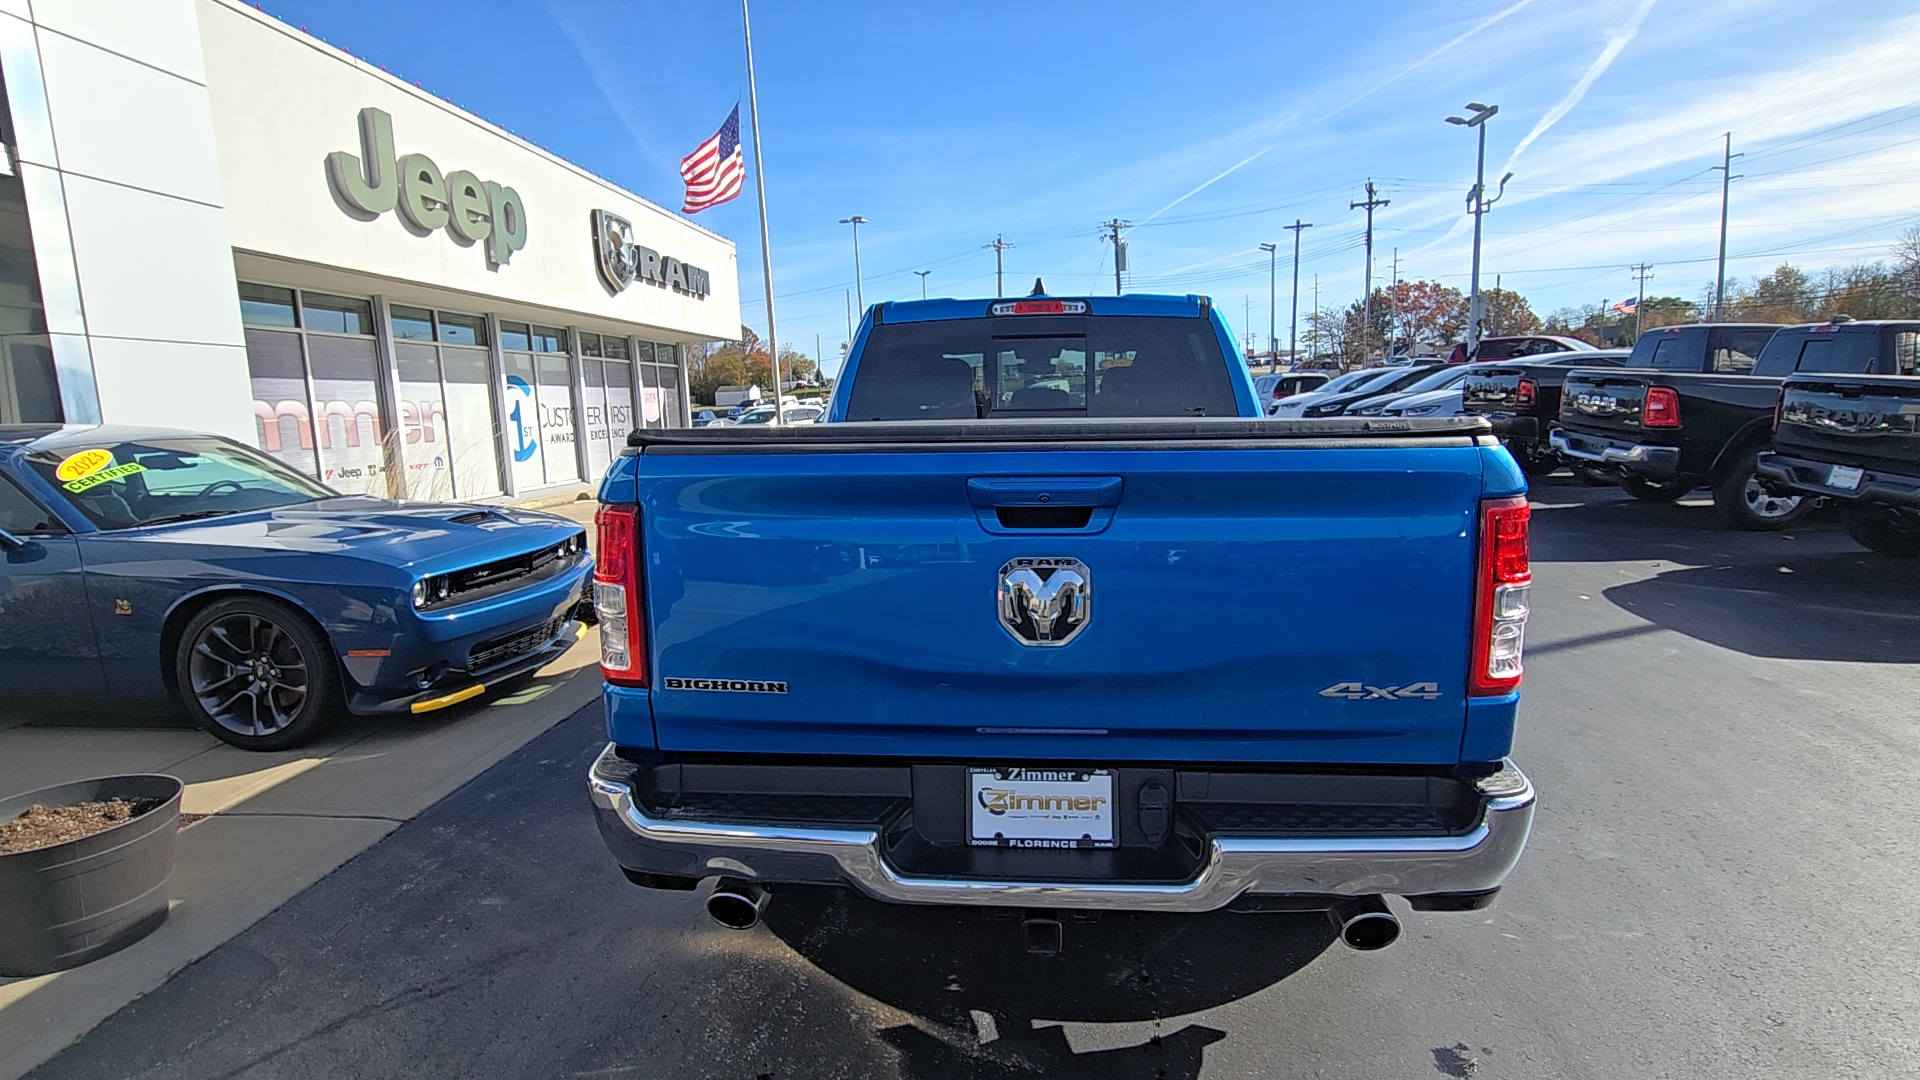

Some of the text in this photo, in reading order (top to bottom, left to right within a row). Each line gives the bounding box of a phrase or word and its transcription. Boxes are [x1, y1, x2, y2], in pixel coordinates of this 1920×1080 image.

[324, 107, 527, 272] Jeep
[634, 245, 711, 300] RAM
[1577, 395, 1617, 407] RAM
[1810, 407, 1883, 426] RAM
[551, 432, 576, 445] AWARD
[66, 452, 105, 476] 2023
[338, 467, 362, 479] Jeep
[68, 464, 140, 491] CERTIFIED
[664, 677, 788, 694] BIGHORN
[1318, 682, 1443, 700] 4x4
[1008, 767, 1076, 781] Zimmer
[986, 789, 1107, 811] Zimmer
[1008, 839, 1078, 848] FLORENCE
